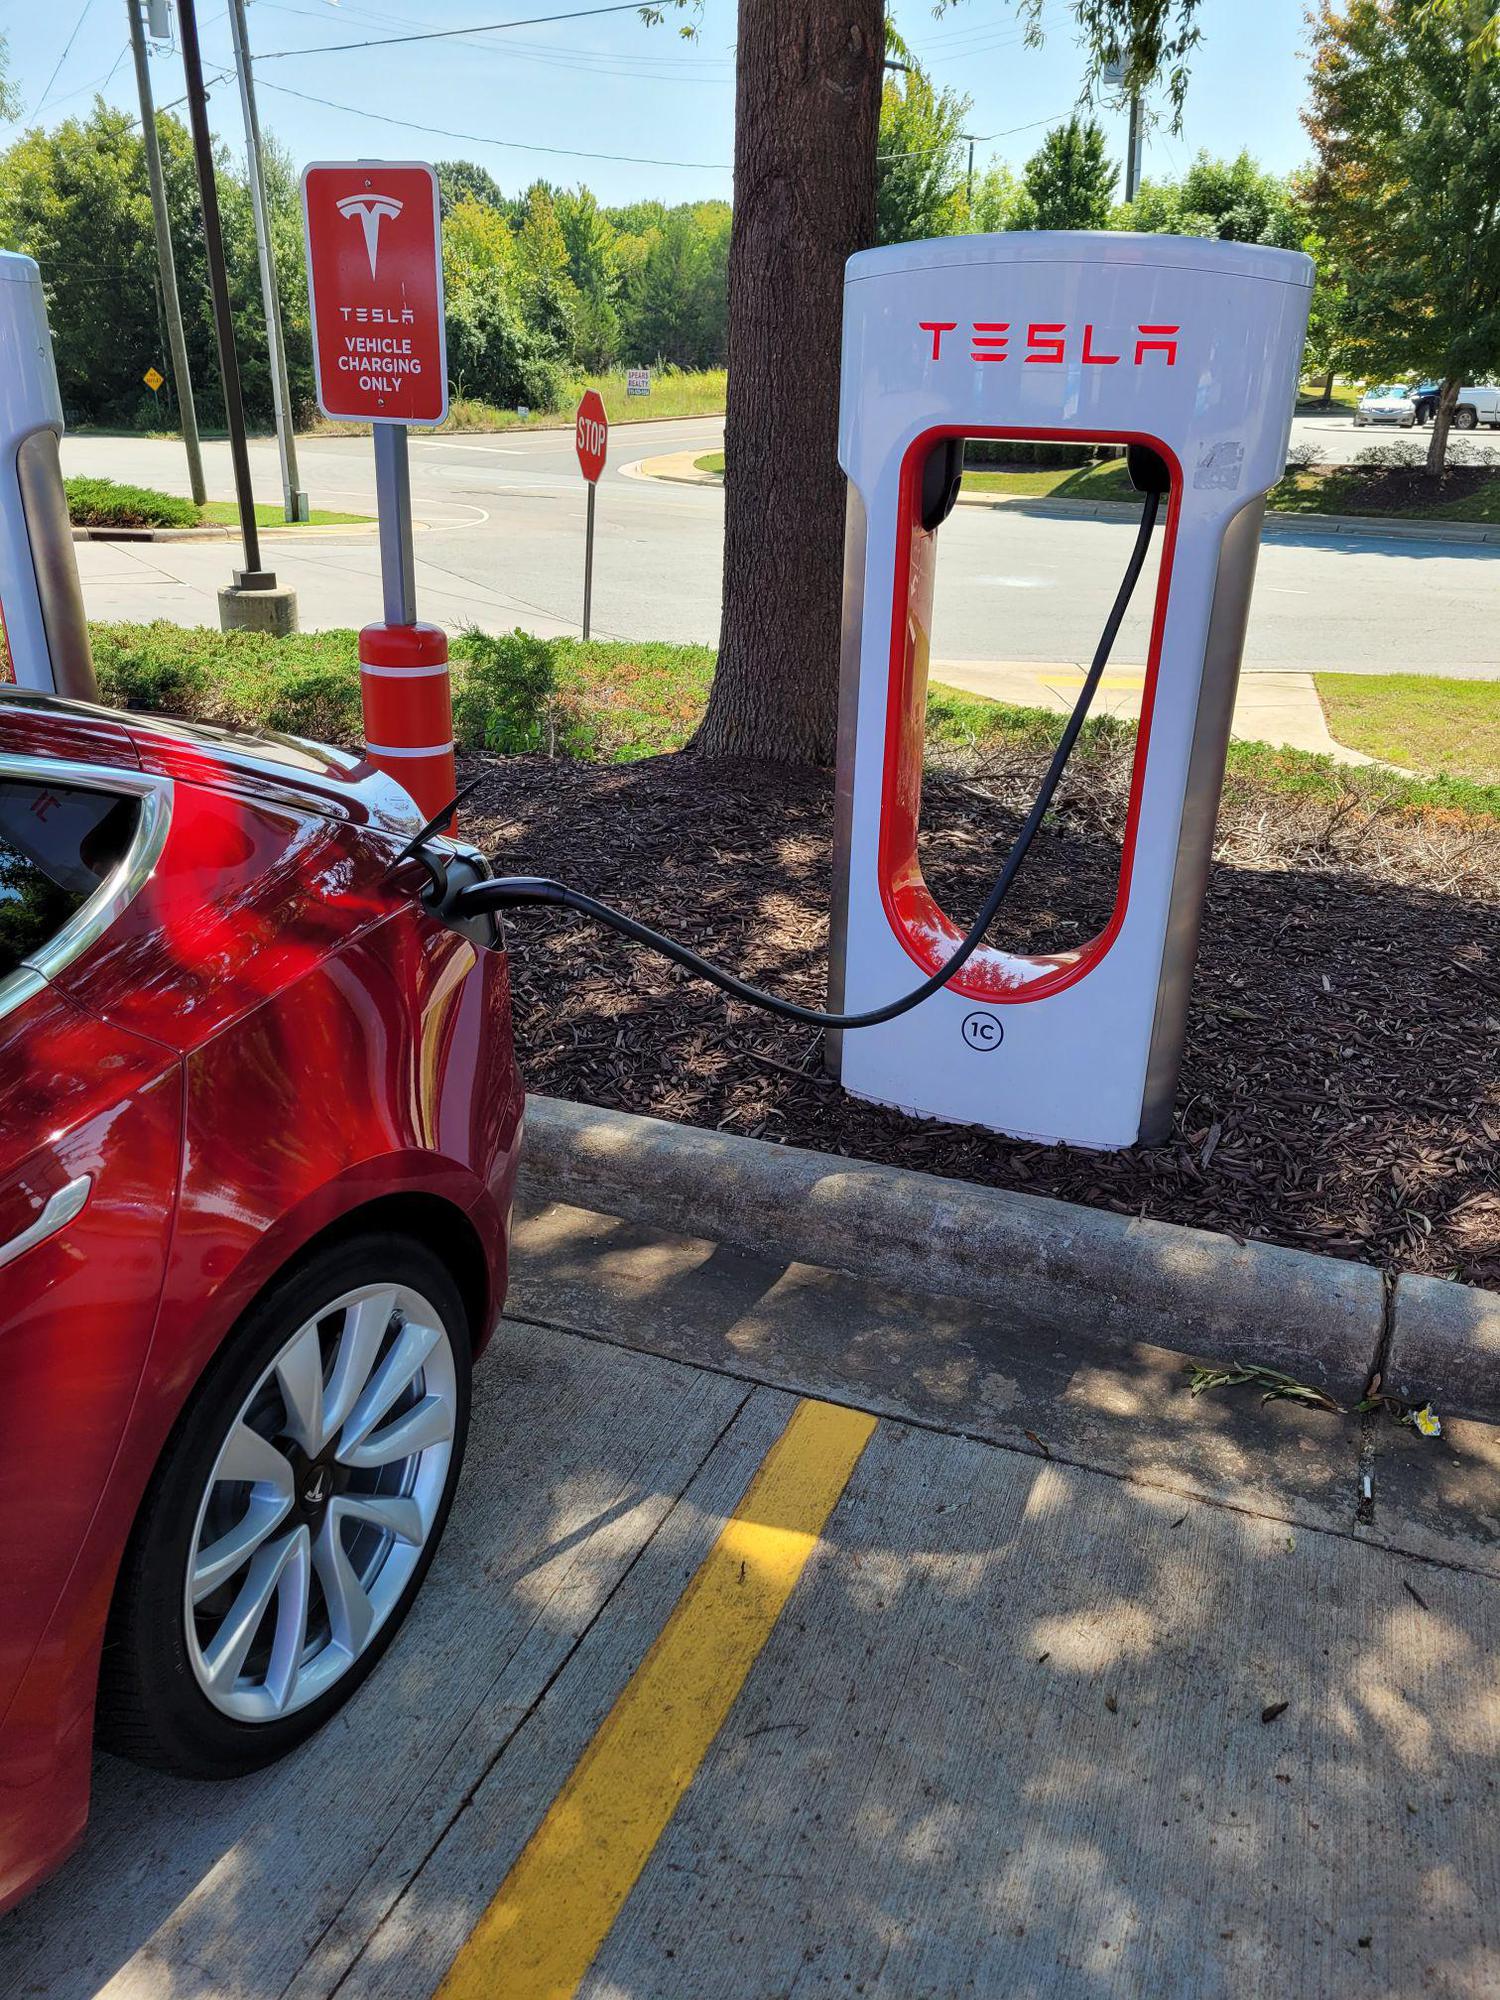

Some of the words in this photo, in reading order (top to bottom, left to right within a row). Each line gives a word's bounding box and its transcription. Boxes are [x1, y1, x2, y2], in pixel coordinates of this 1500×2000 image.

[339, 307, 414, 324] TESLA
[345, 337, 412, 354] VEHICLE
[918, 322, 1181, 366] TESLA
[338, 356, 422, 374] CHARGING
[359, 375, 402, 392] ONLY
[577, 416, 606, 457] STOP
[971, 1022, 995, 1040] 1C
